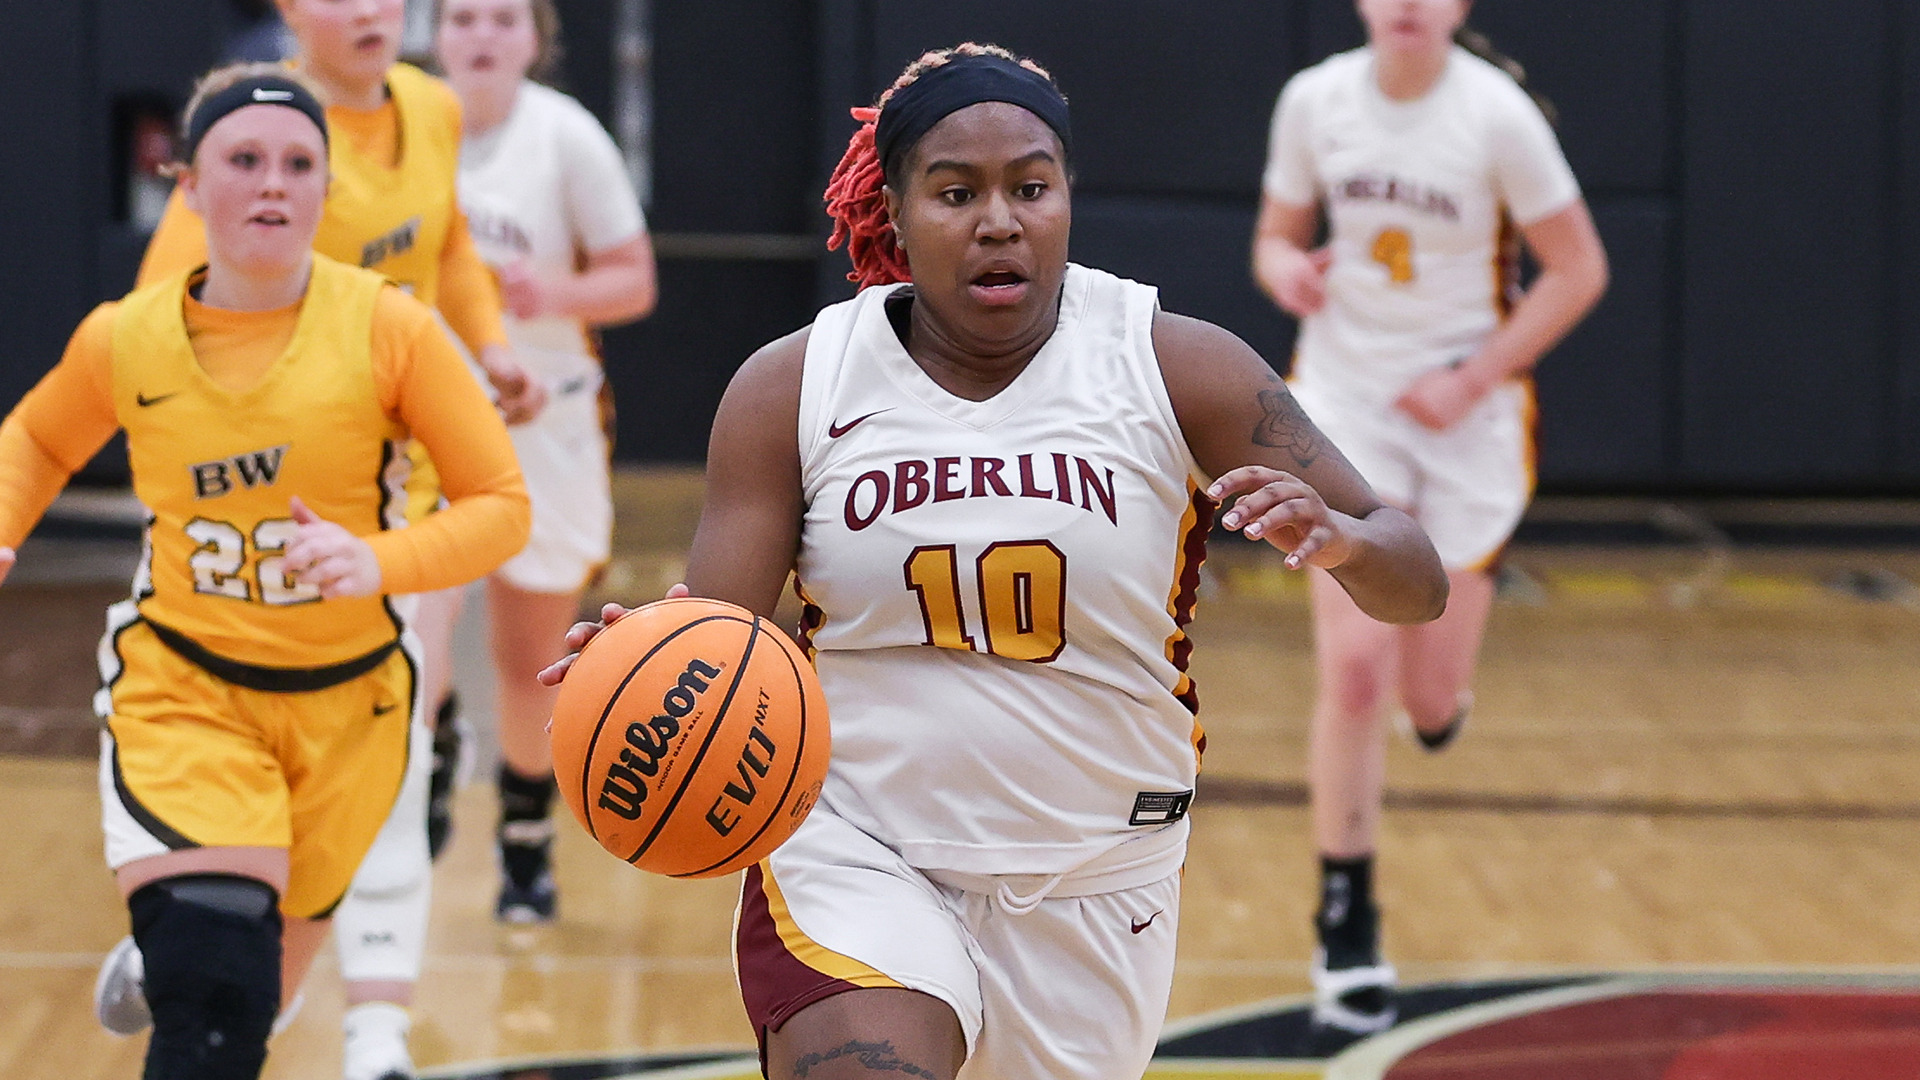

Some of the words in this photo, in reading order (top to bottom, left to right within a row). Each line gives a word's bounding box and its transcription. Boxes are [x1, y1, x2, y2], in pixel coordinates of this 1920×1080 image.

[189, 443, 290, 500] BW
[844, 452, 1118, 532] OBERLIN
[183, 515, 323, 606] 22
[903, 539, 1067, 664] 10
[598, 657, 721, 821] Wilson
[687, 710, 704, 731] BALL
[754, 690, 770, 727] NXT
[1175, 801, 1182, 814] L
